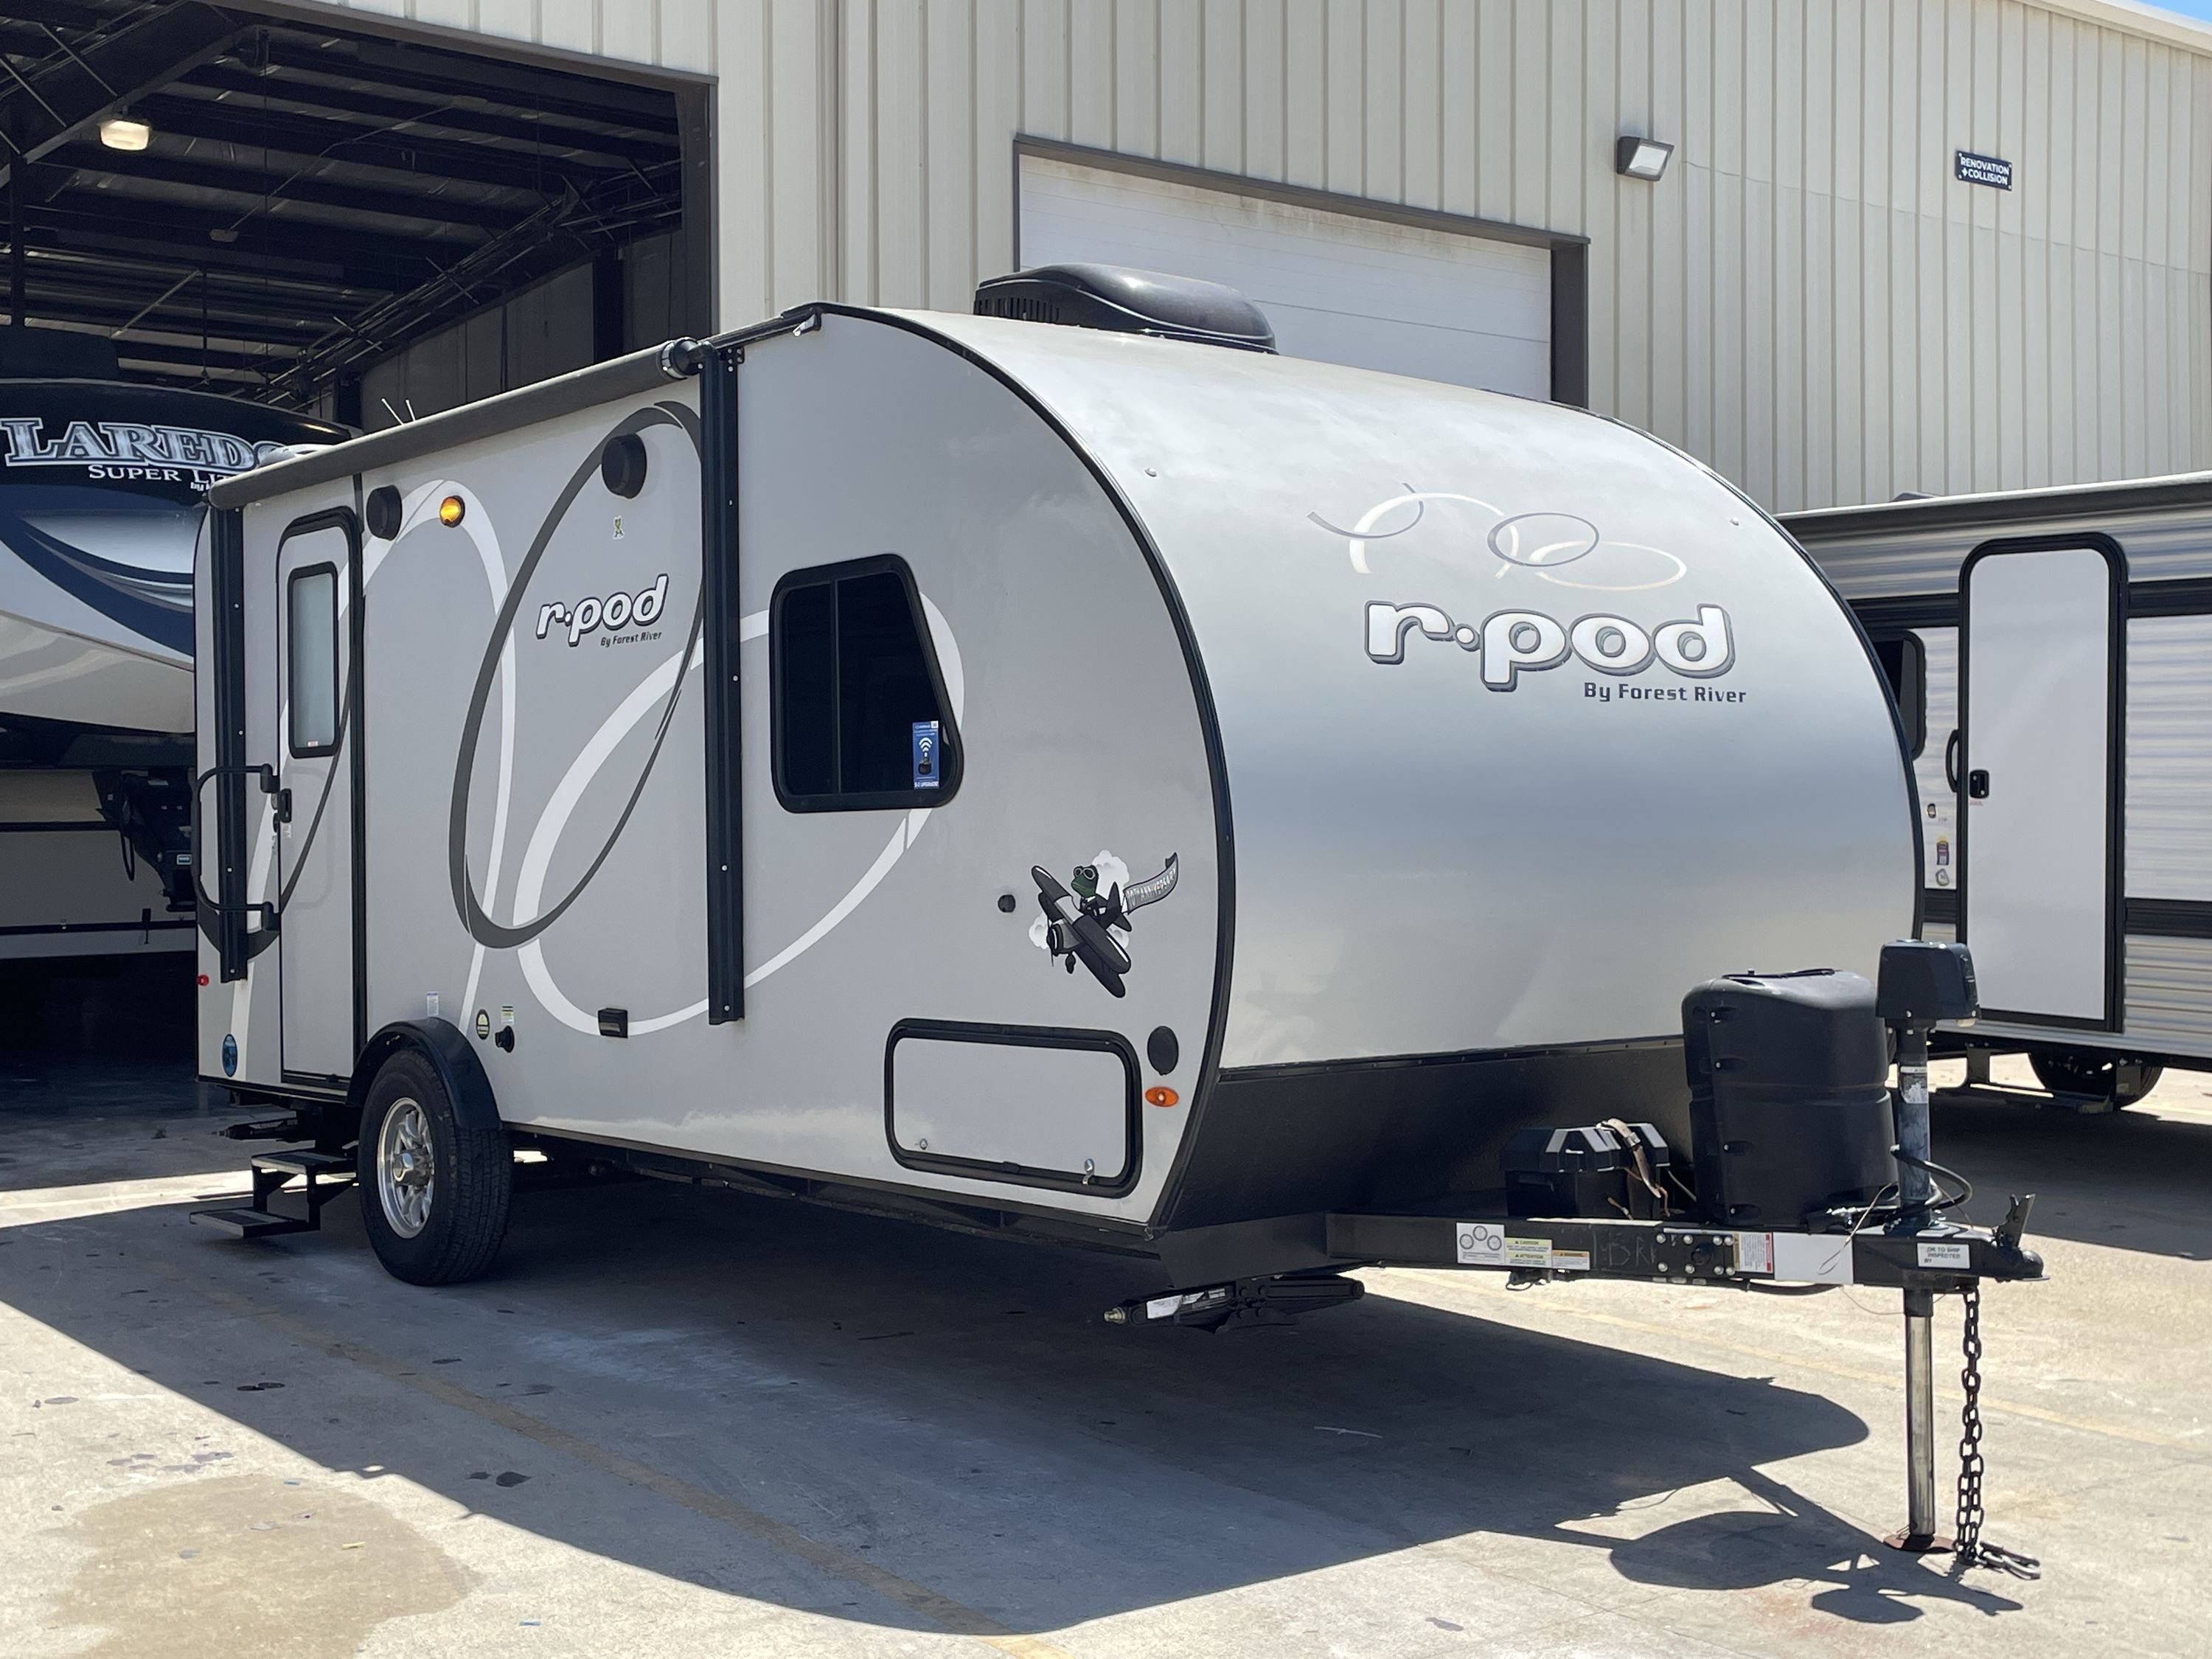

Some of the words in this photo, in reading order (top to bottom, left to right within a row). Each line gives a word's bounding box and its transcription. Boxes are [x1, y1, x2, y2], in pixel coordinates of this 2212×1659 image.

[1960, 156, 2010, 176] RENOVATION
[612, 634, 639, 645] Forest
[640, 631, 662, 641] River
[1585, 681, 1610, 702] By
[1618, 683, 1688, 700] Forest
[1694, 686, 1747, 703] River
